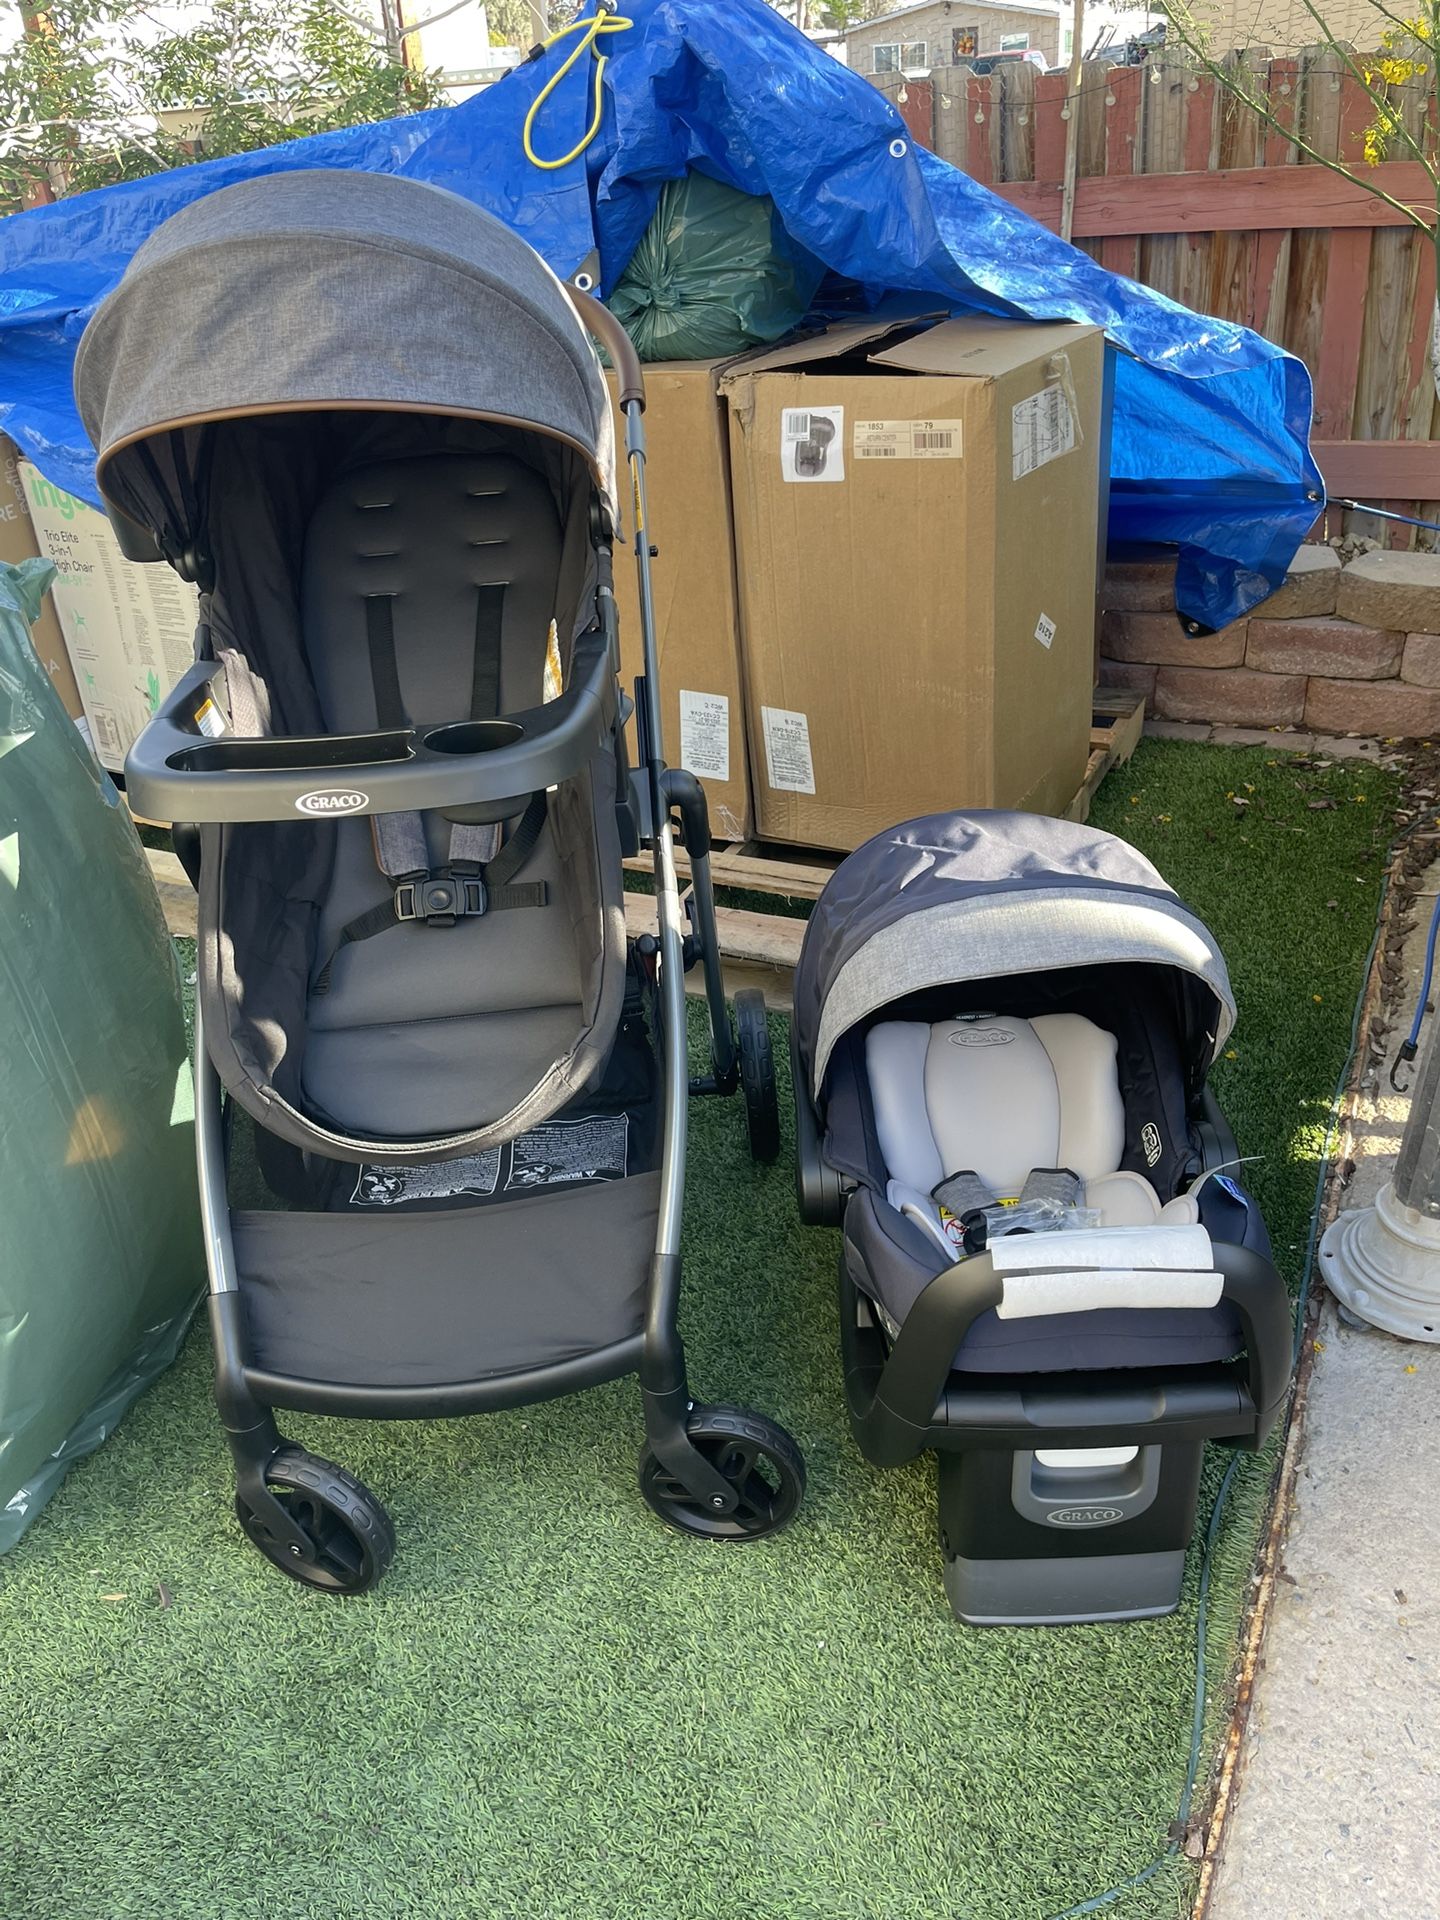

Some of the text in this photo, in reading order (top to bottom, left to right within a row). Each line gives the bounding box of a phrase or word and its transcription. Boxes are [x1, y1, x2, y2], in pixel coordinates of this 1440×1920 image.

[924, 421, 933, 430] 79
[43, 529, 60, 542] Trio
[60, 530, 79, 544] Elite
[49, 544, 73, 557] 3-in-1
[72, 560, 95, 573] Chair
[305, 794, 362, 809] GRACO
[957, 1031, 1011, 1043] GRACO
[1058, 1510, 1116, 1521] GRACO
